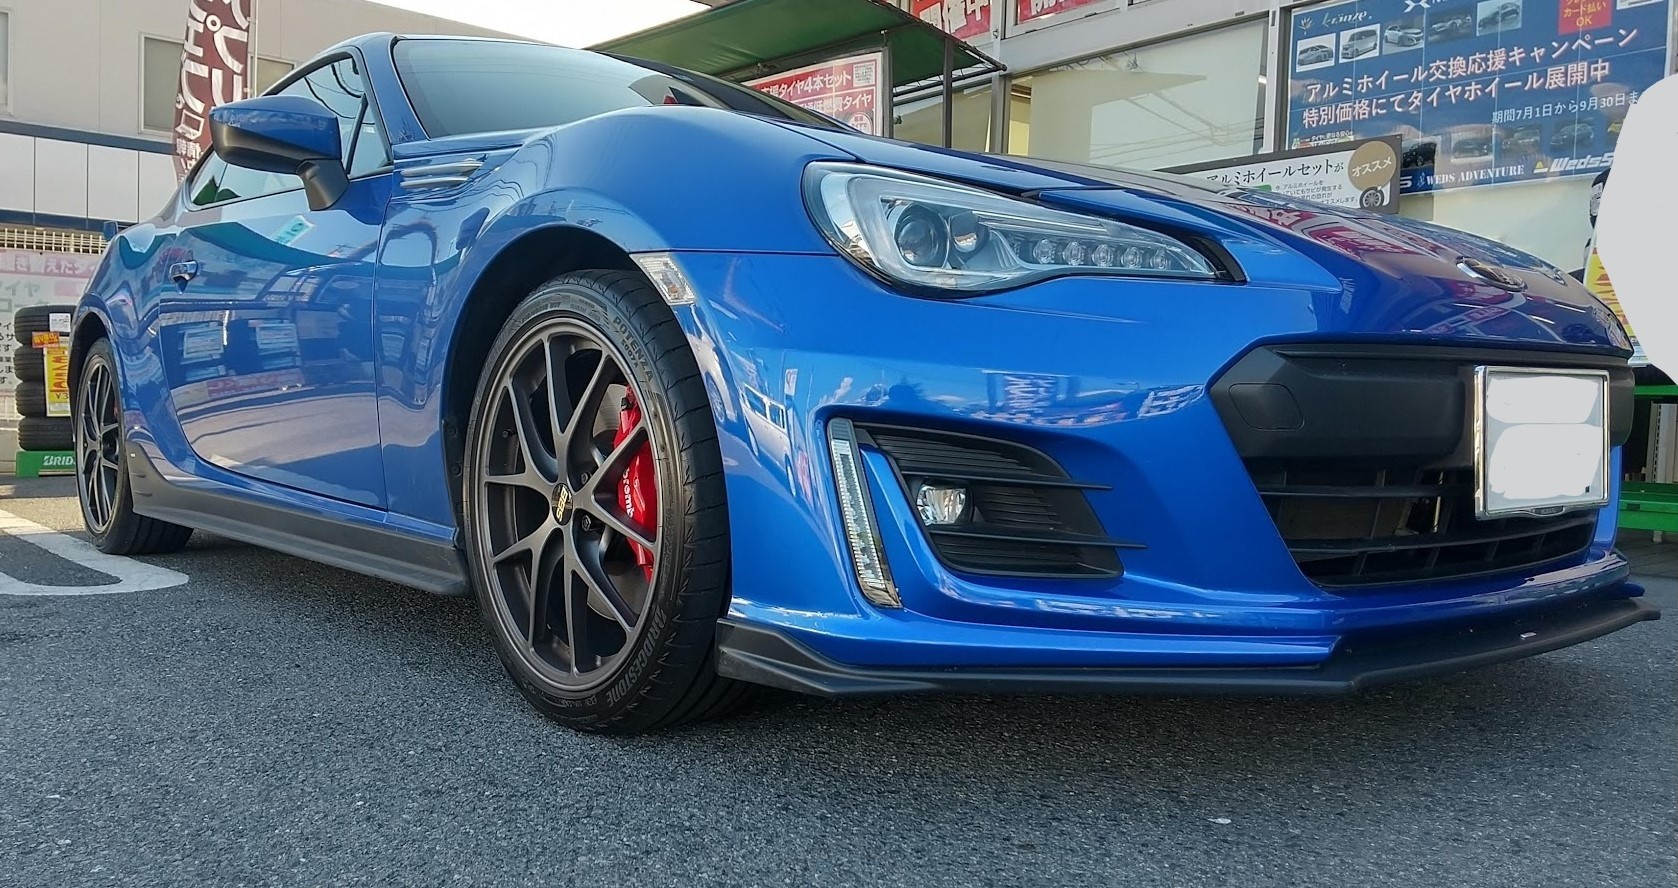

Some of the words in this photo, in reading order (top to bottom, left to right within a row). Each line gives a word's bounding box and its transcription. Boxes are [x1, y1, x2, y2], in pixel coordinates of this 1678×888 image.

[1576, 15, 1592, 27] OK
[1306, 28, 1638, 102] アルミホイール交換応援キャンペーン
[1302, 58, 1610, 129] 特別価格にてタイヤホイール展開中
[1351, 155, 1392, 178] オススメ
[1426, 173, 1455, 186] WEDS
[1458, 165, 1524, 182] ADVENTURE
[612, 316, 654, 382] POTENZA
[43, 455, 76, 466] BRID
[555, 484, 569, 522] BBS
[605, 604, 667, 708] BRIDGESTONE
